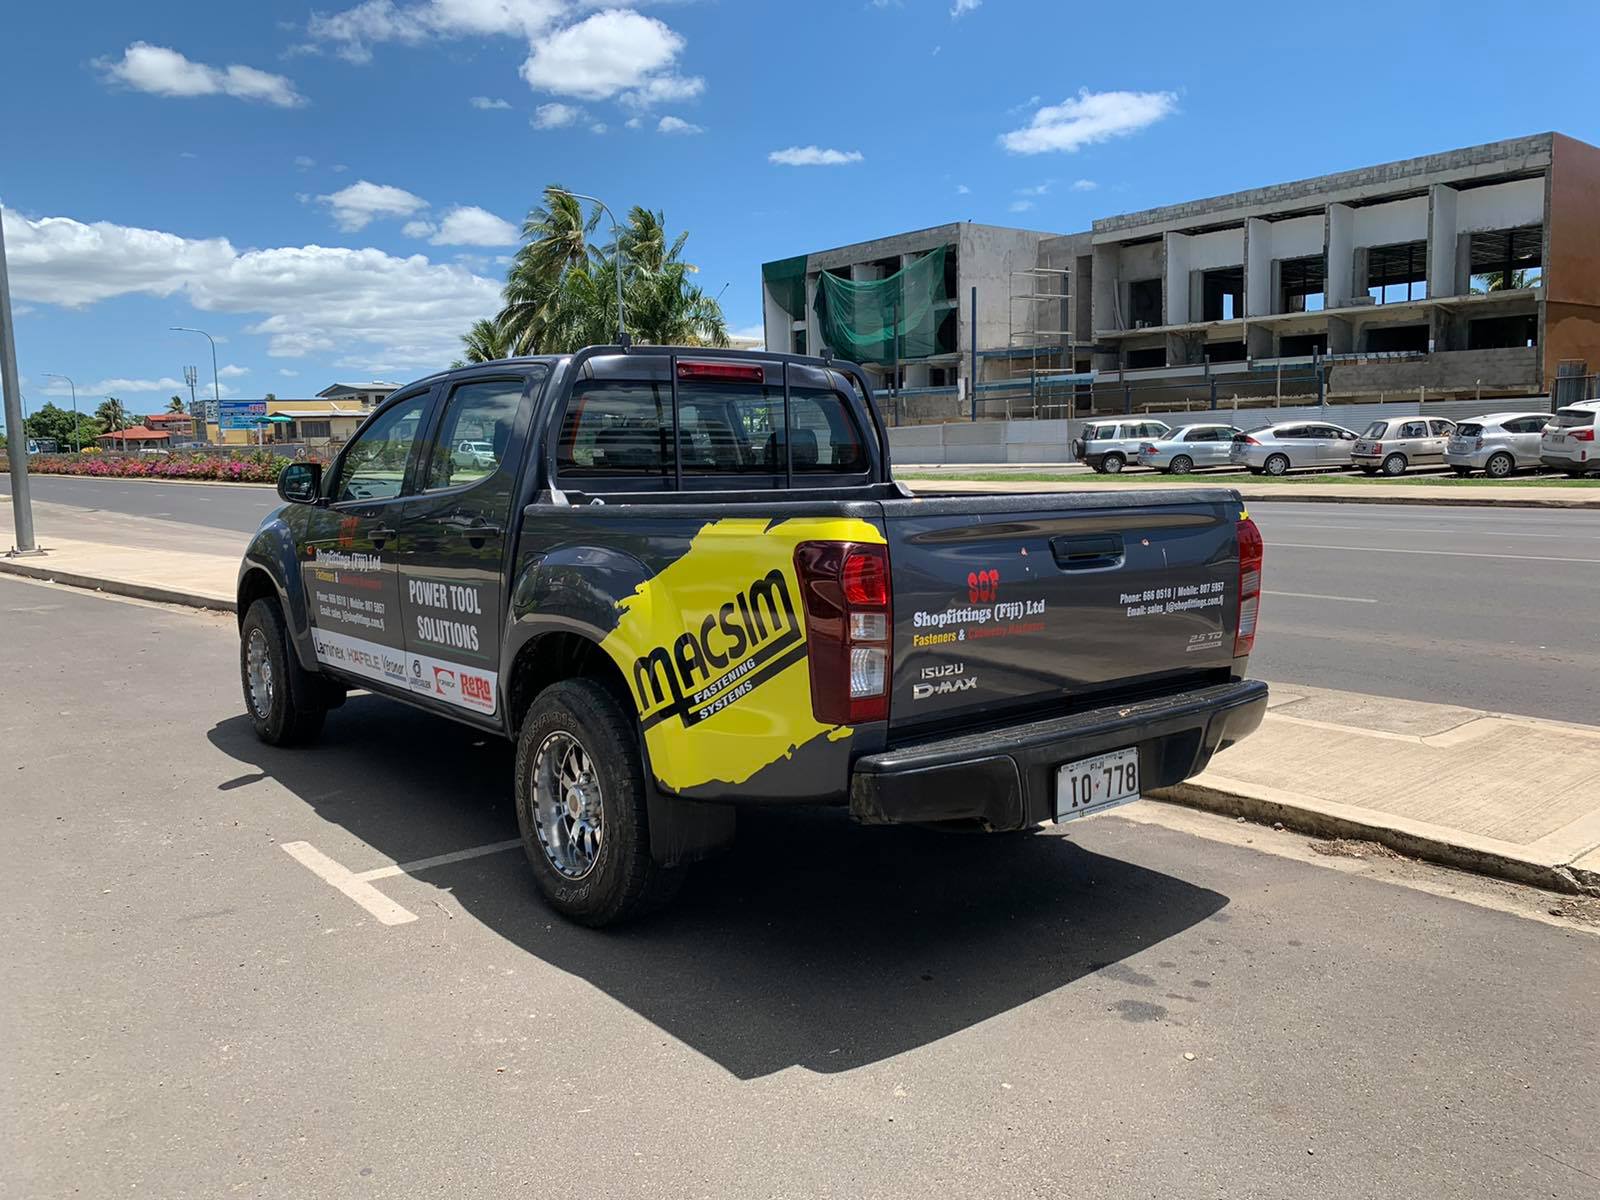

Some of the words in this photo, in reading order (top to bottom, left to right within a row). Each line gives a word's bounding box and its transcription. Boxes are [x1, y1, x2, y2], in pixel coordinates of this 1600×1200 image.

[409, 580, 448, 609] POWER
[450, 587, 482, 615] TOOL
[913, 607, 991, 628] Shopfittings
[994, 602, 1023, 622] (Fiji)
[1026, 599, 1045, 615] Ltd
[417, 616, 479, 651] SOLUTIONS
[633, 569, 802, 711] MACSIM
[913, 632, 956, 647] Fasteners
[958, 629, 965, 641] &
[693, 658, 756, 704] FASTENING
[921, 663, 964, 679] ISUZU
[700, 680, 753, 720] SYSTEMS
[1103, 762, 1136, 798] 778
